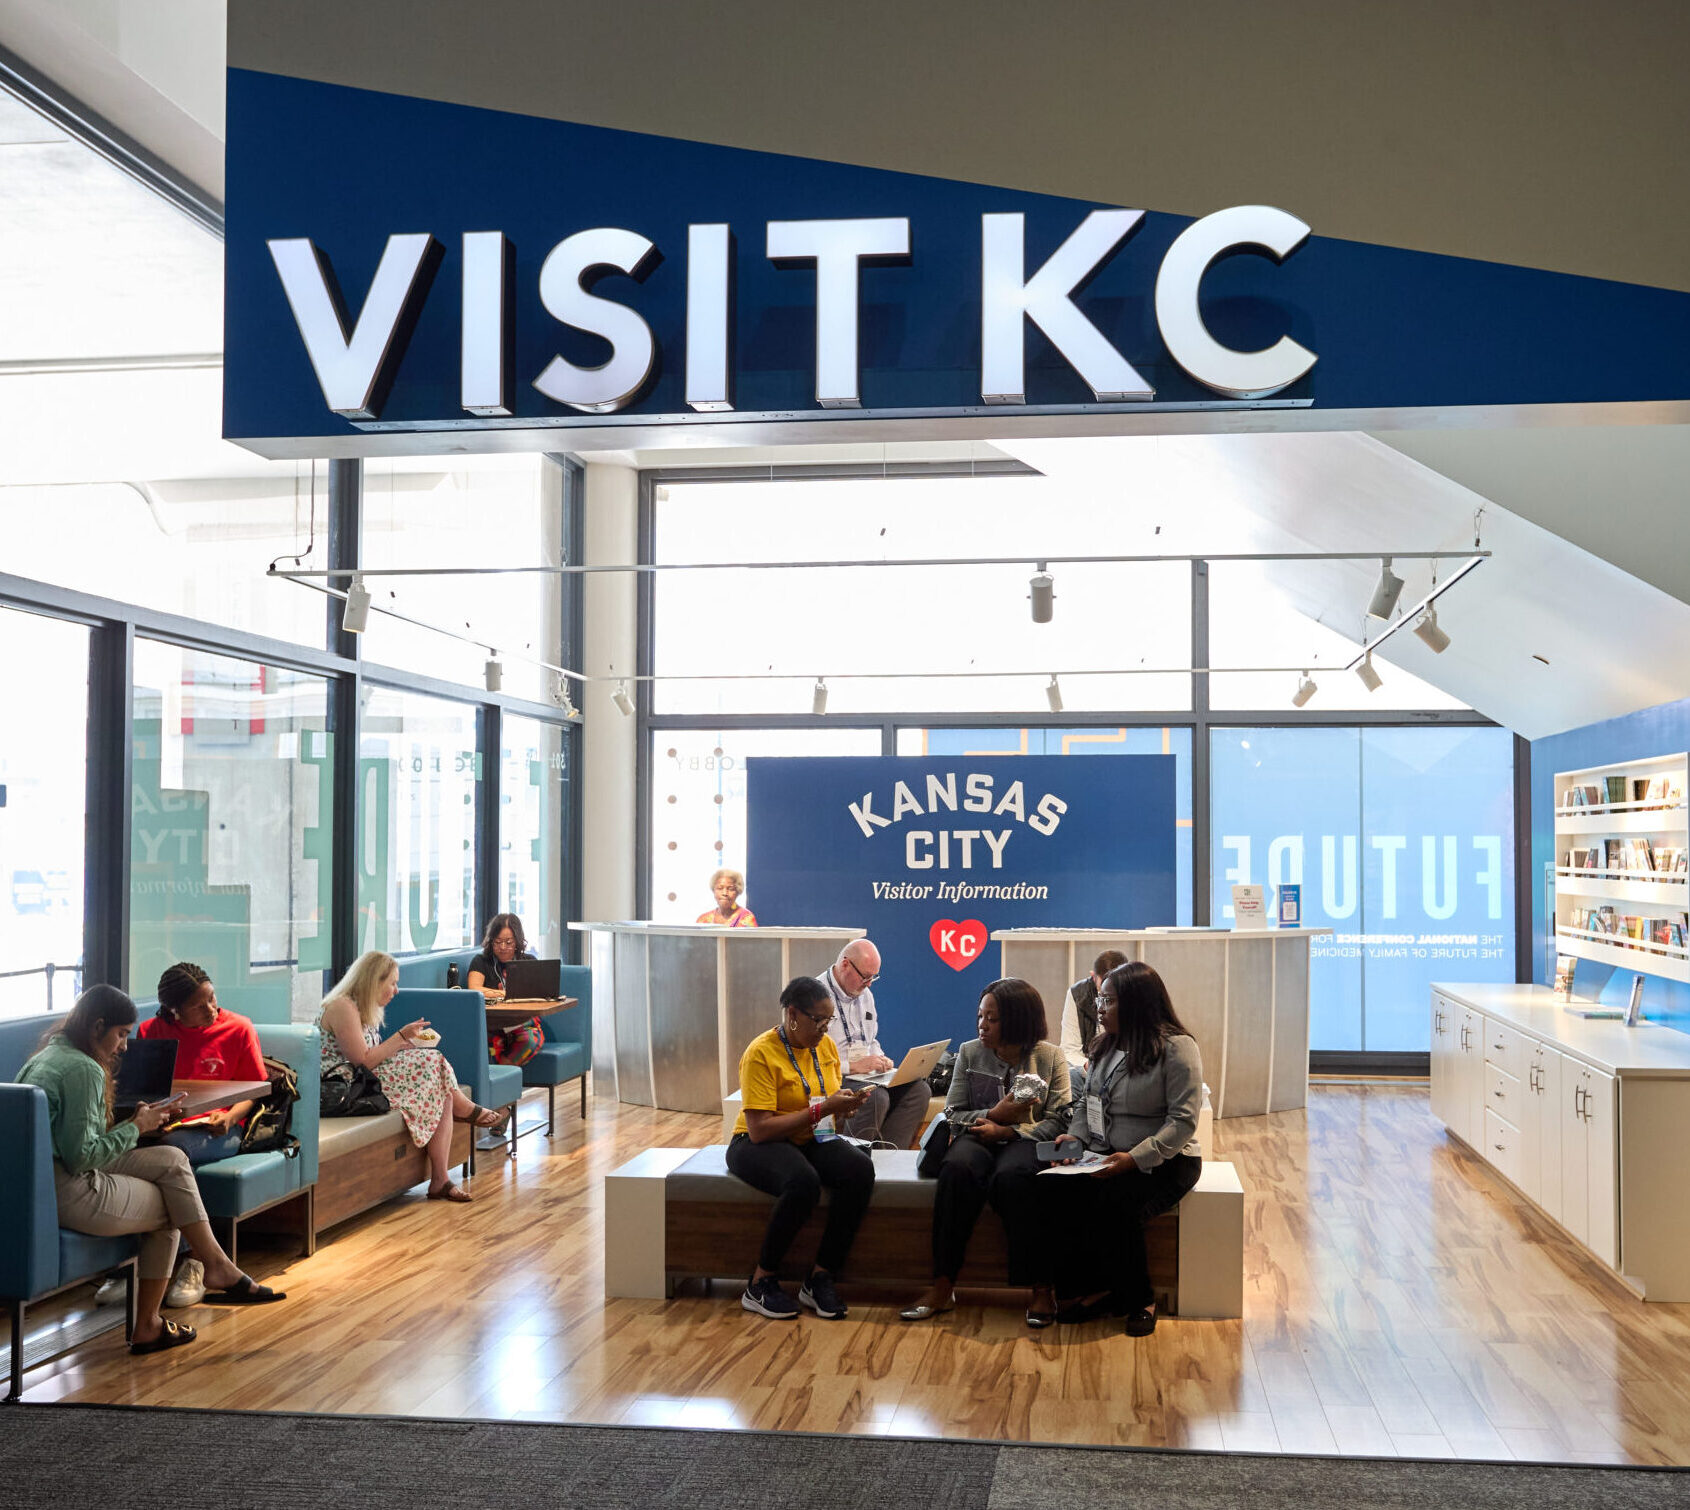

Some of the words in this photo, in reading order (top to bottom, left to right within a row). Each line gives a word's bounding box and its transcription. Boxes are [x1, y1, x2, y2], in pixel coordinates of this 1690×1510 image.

[267, 217, 912, 416] VISIT
[981, 204, 1318, 402] KC
[848, 773, 1068, 838] KANSAS
[906, 829, 1013, 869] CITY
[872, 881, 933, 900] Visitor
[936, 881, 1048, 903] Information
[941, 930, 976, 957] KC
